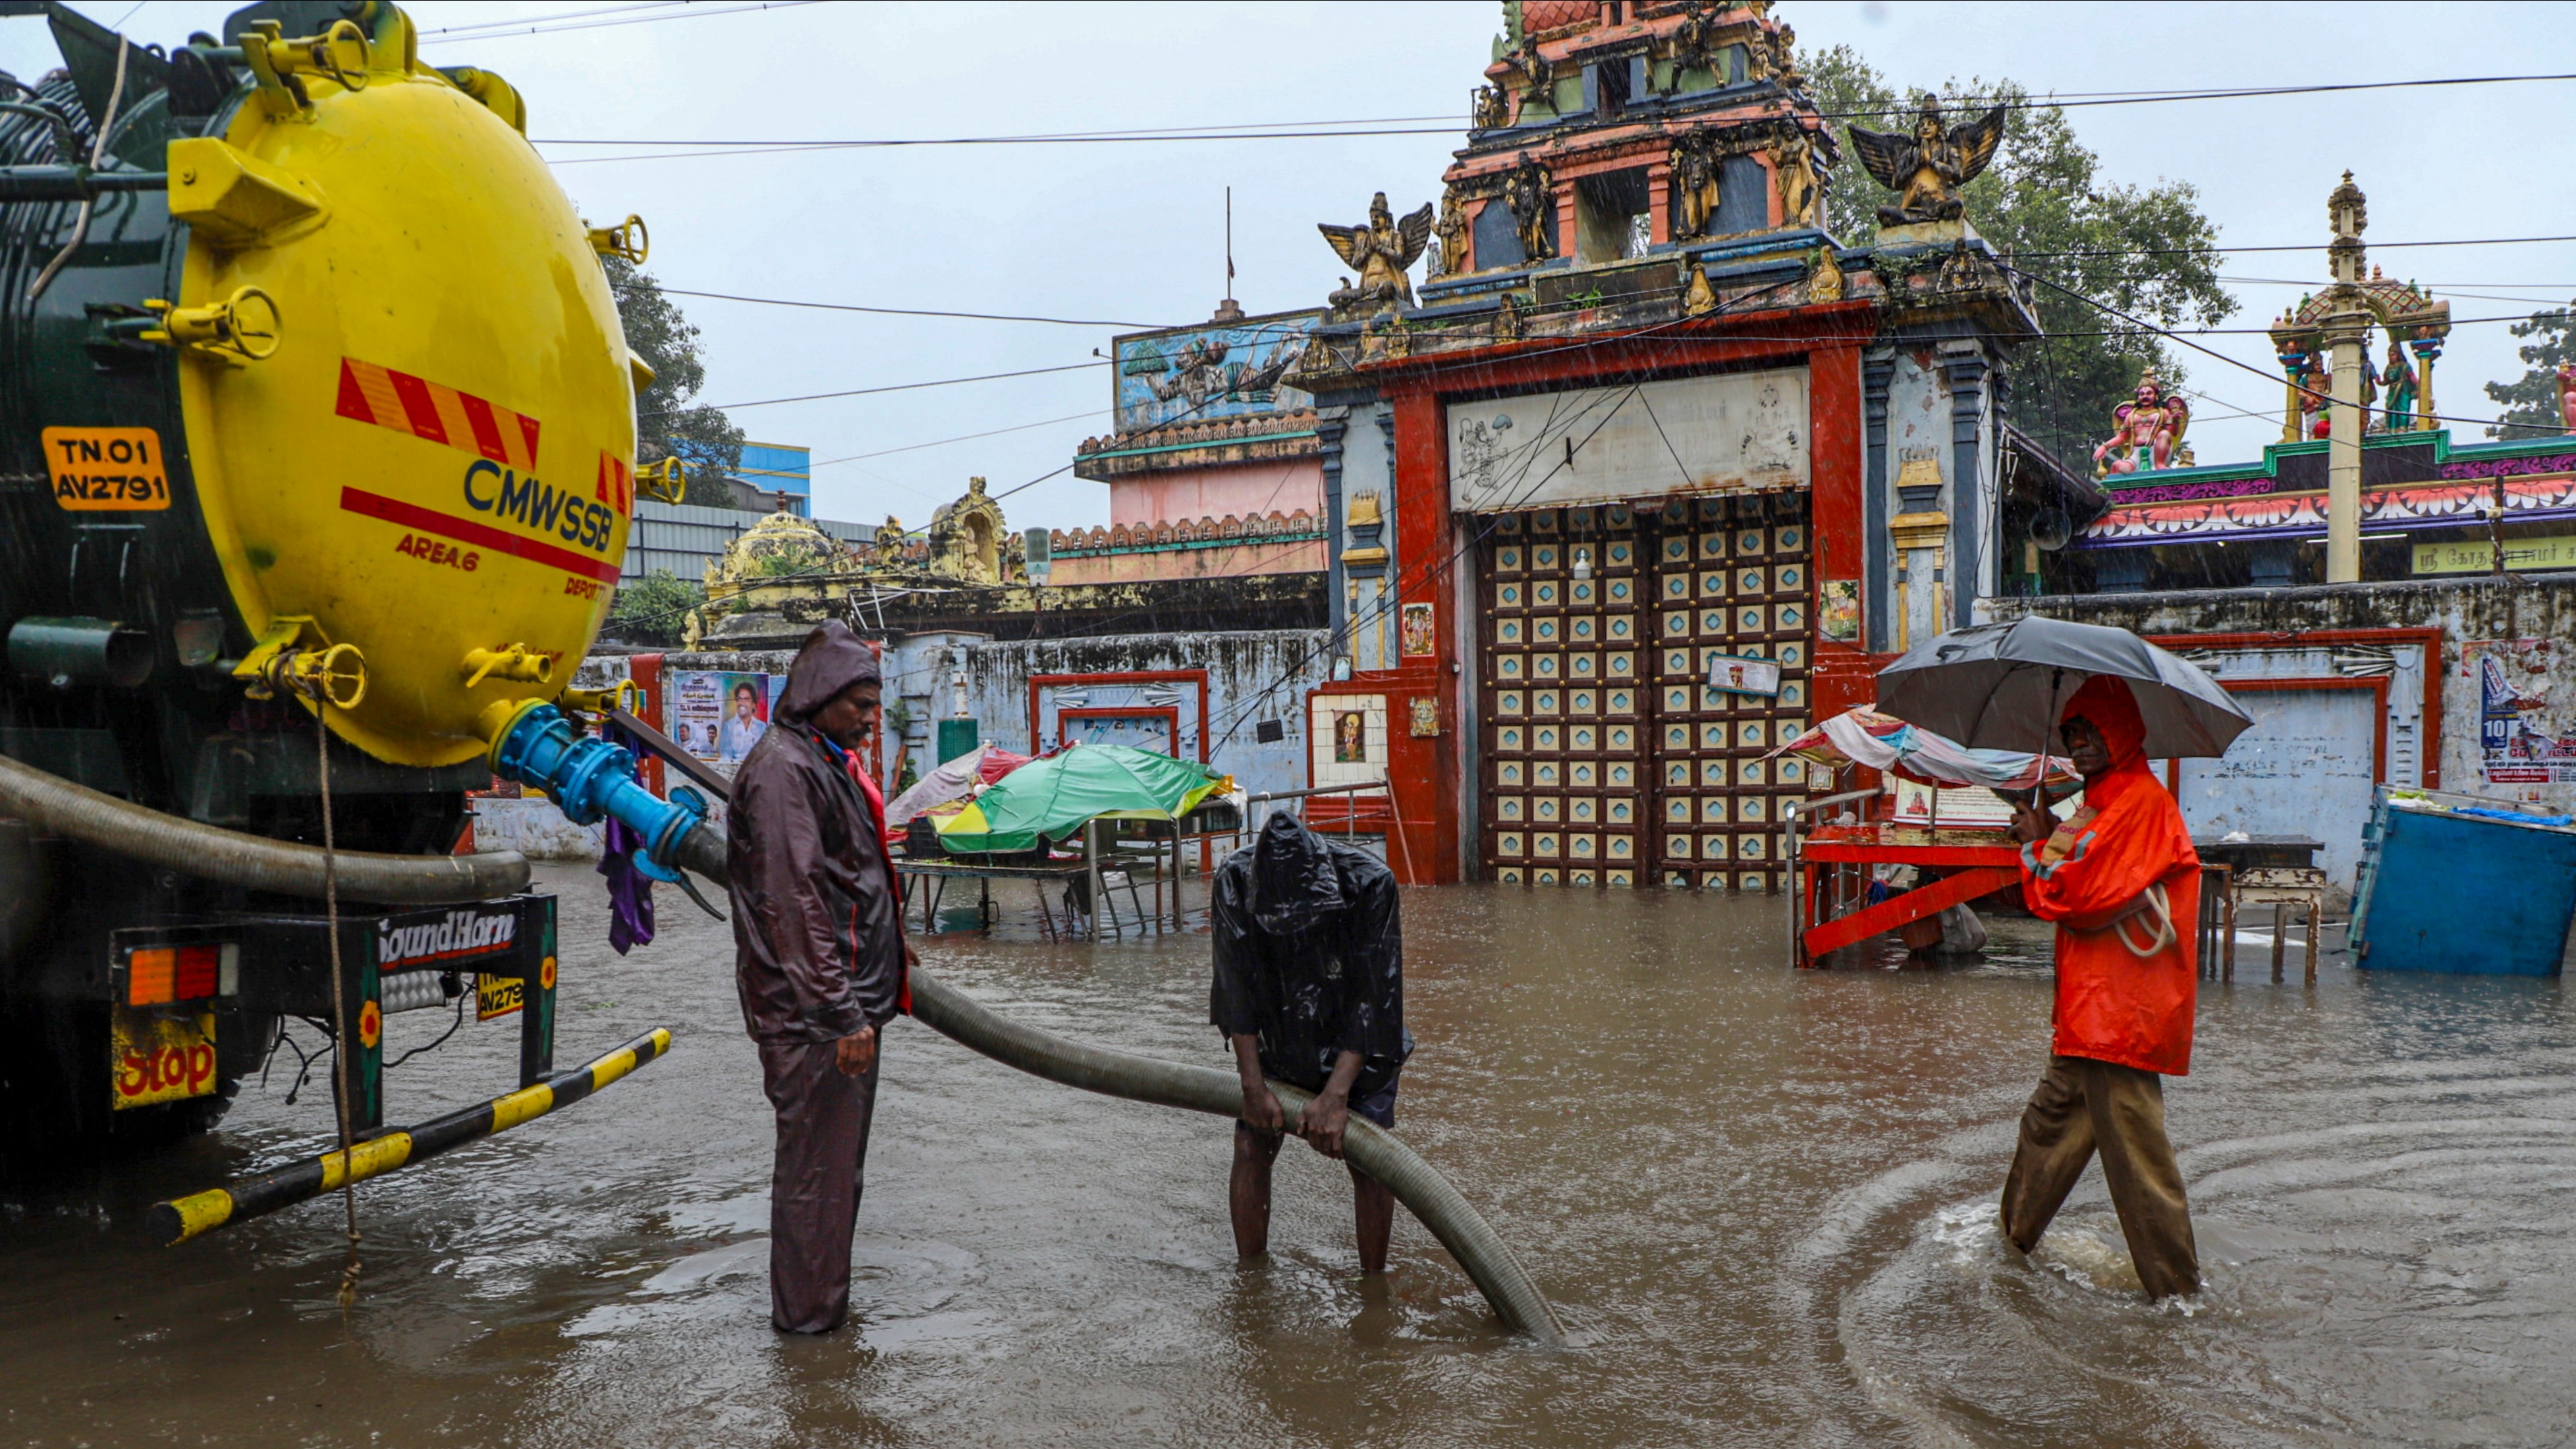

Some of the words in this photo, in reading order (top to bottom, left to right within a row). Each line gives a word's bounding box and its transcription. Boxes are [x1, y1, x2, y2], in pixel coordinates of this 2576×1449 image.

[57, 439, 148, 464] TN.01
[464, 459, 613, 552] CMWSSB
[395, 533, 480, 571] AREA.6
[2484, 720, 2505, 737] 10
[480, 983, 523, 1012] AV279
[119, 1043, 213, 1097] Stop
